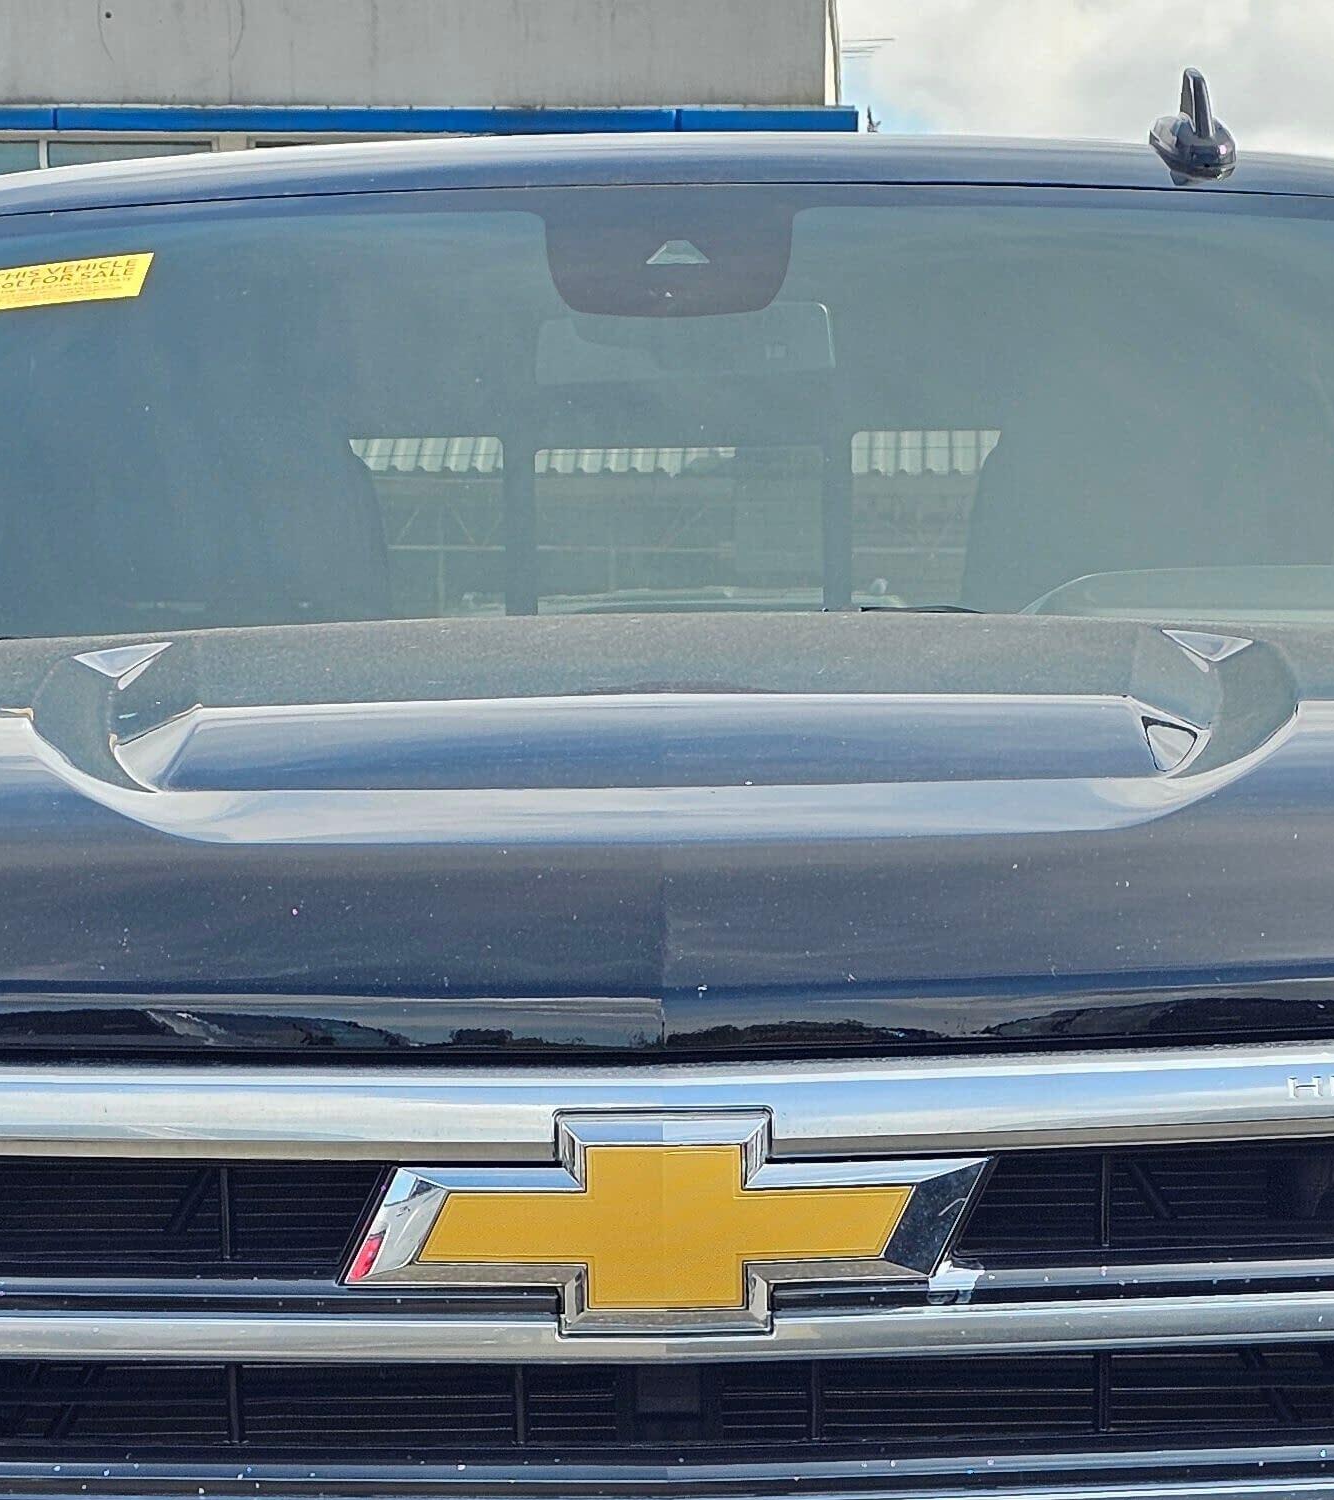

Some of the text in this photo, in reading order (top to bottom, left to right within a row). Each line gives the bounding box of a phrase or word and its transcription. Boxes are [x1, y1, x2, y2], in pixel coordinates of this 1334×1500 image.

[47, 259, 139, 274] VEHICLE
[30, 275, 71, 285] FOR
[81, 267, 134, 279] SALE
